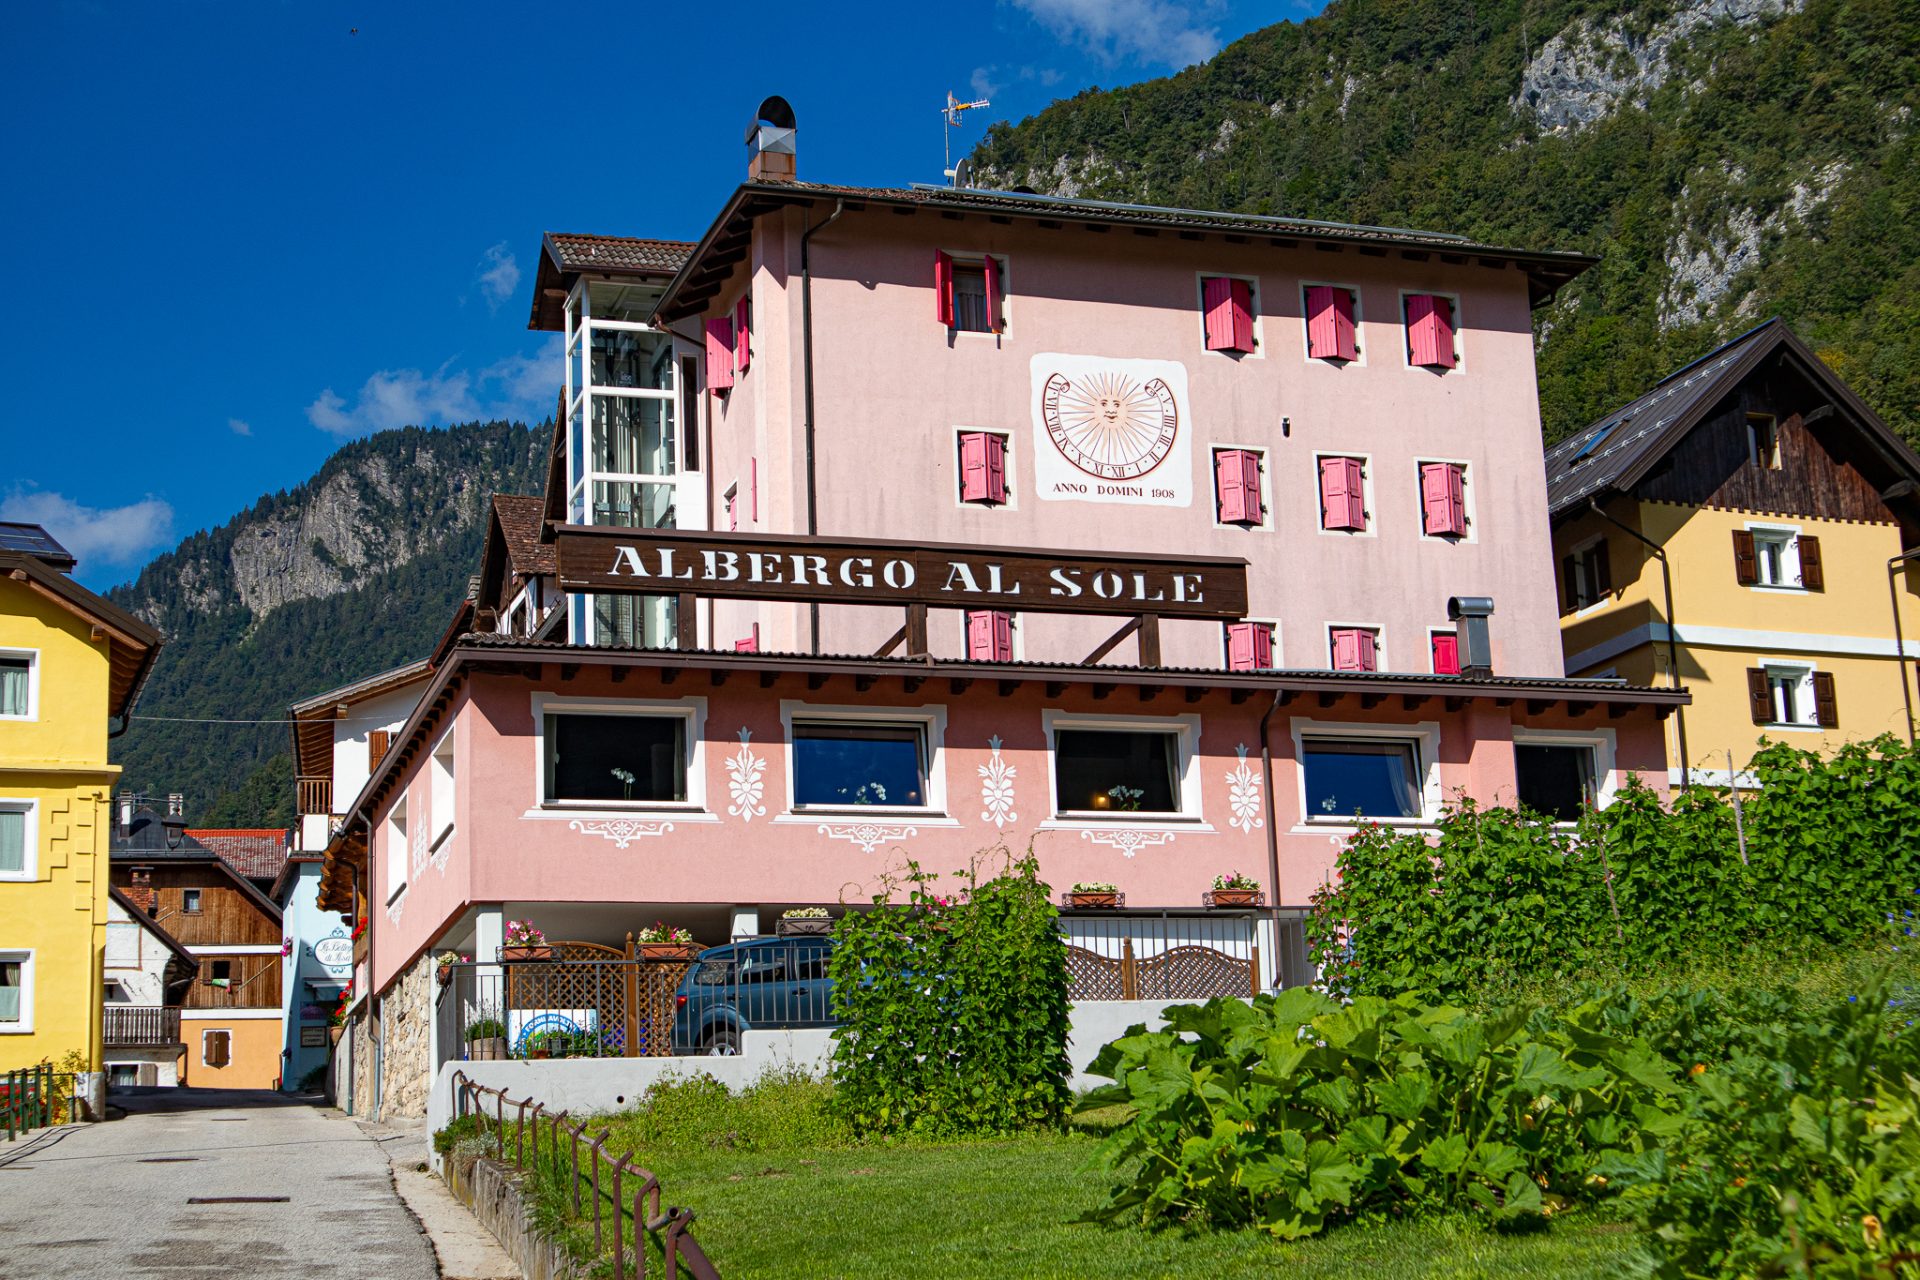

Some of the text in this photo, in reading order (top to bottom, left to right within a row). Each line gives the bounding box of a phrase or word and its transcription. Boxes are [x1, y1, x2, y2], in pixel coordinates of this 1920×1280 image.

[1092, 463, 1104, 476] XI
[1112, 466, 1126, 478] XII
[1053, 483, 1175, 498] ANNO DOMINI 1908
[606, 545, 1204, 603] ALBERGO AL SOLE
[525, 1016, 547, 1032] FORNI
